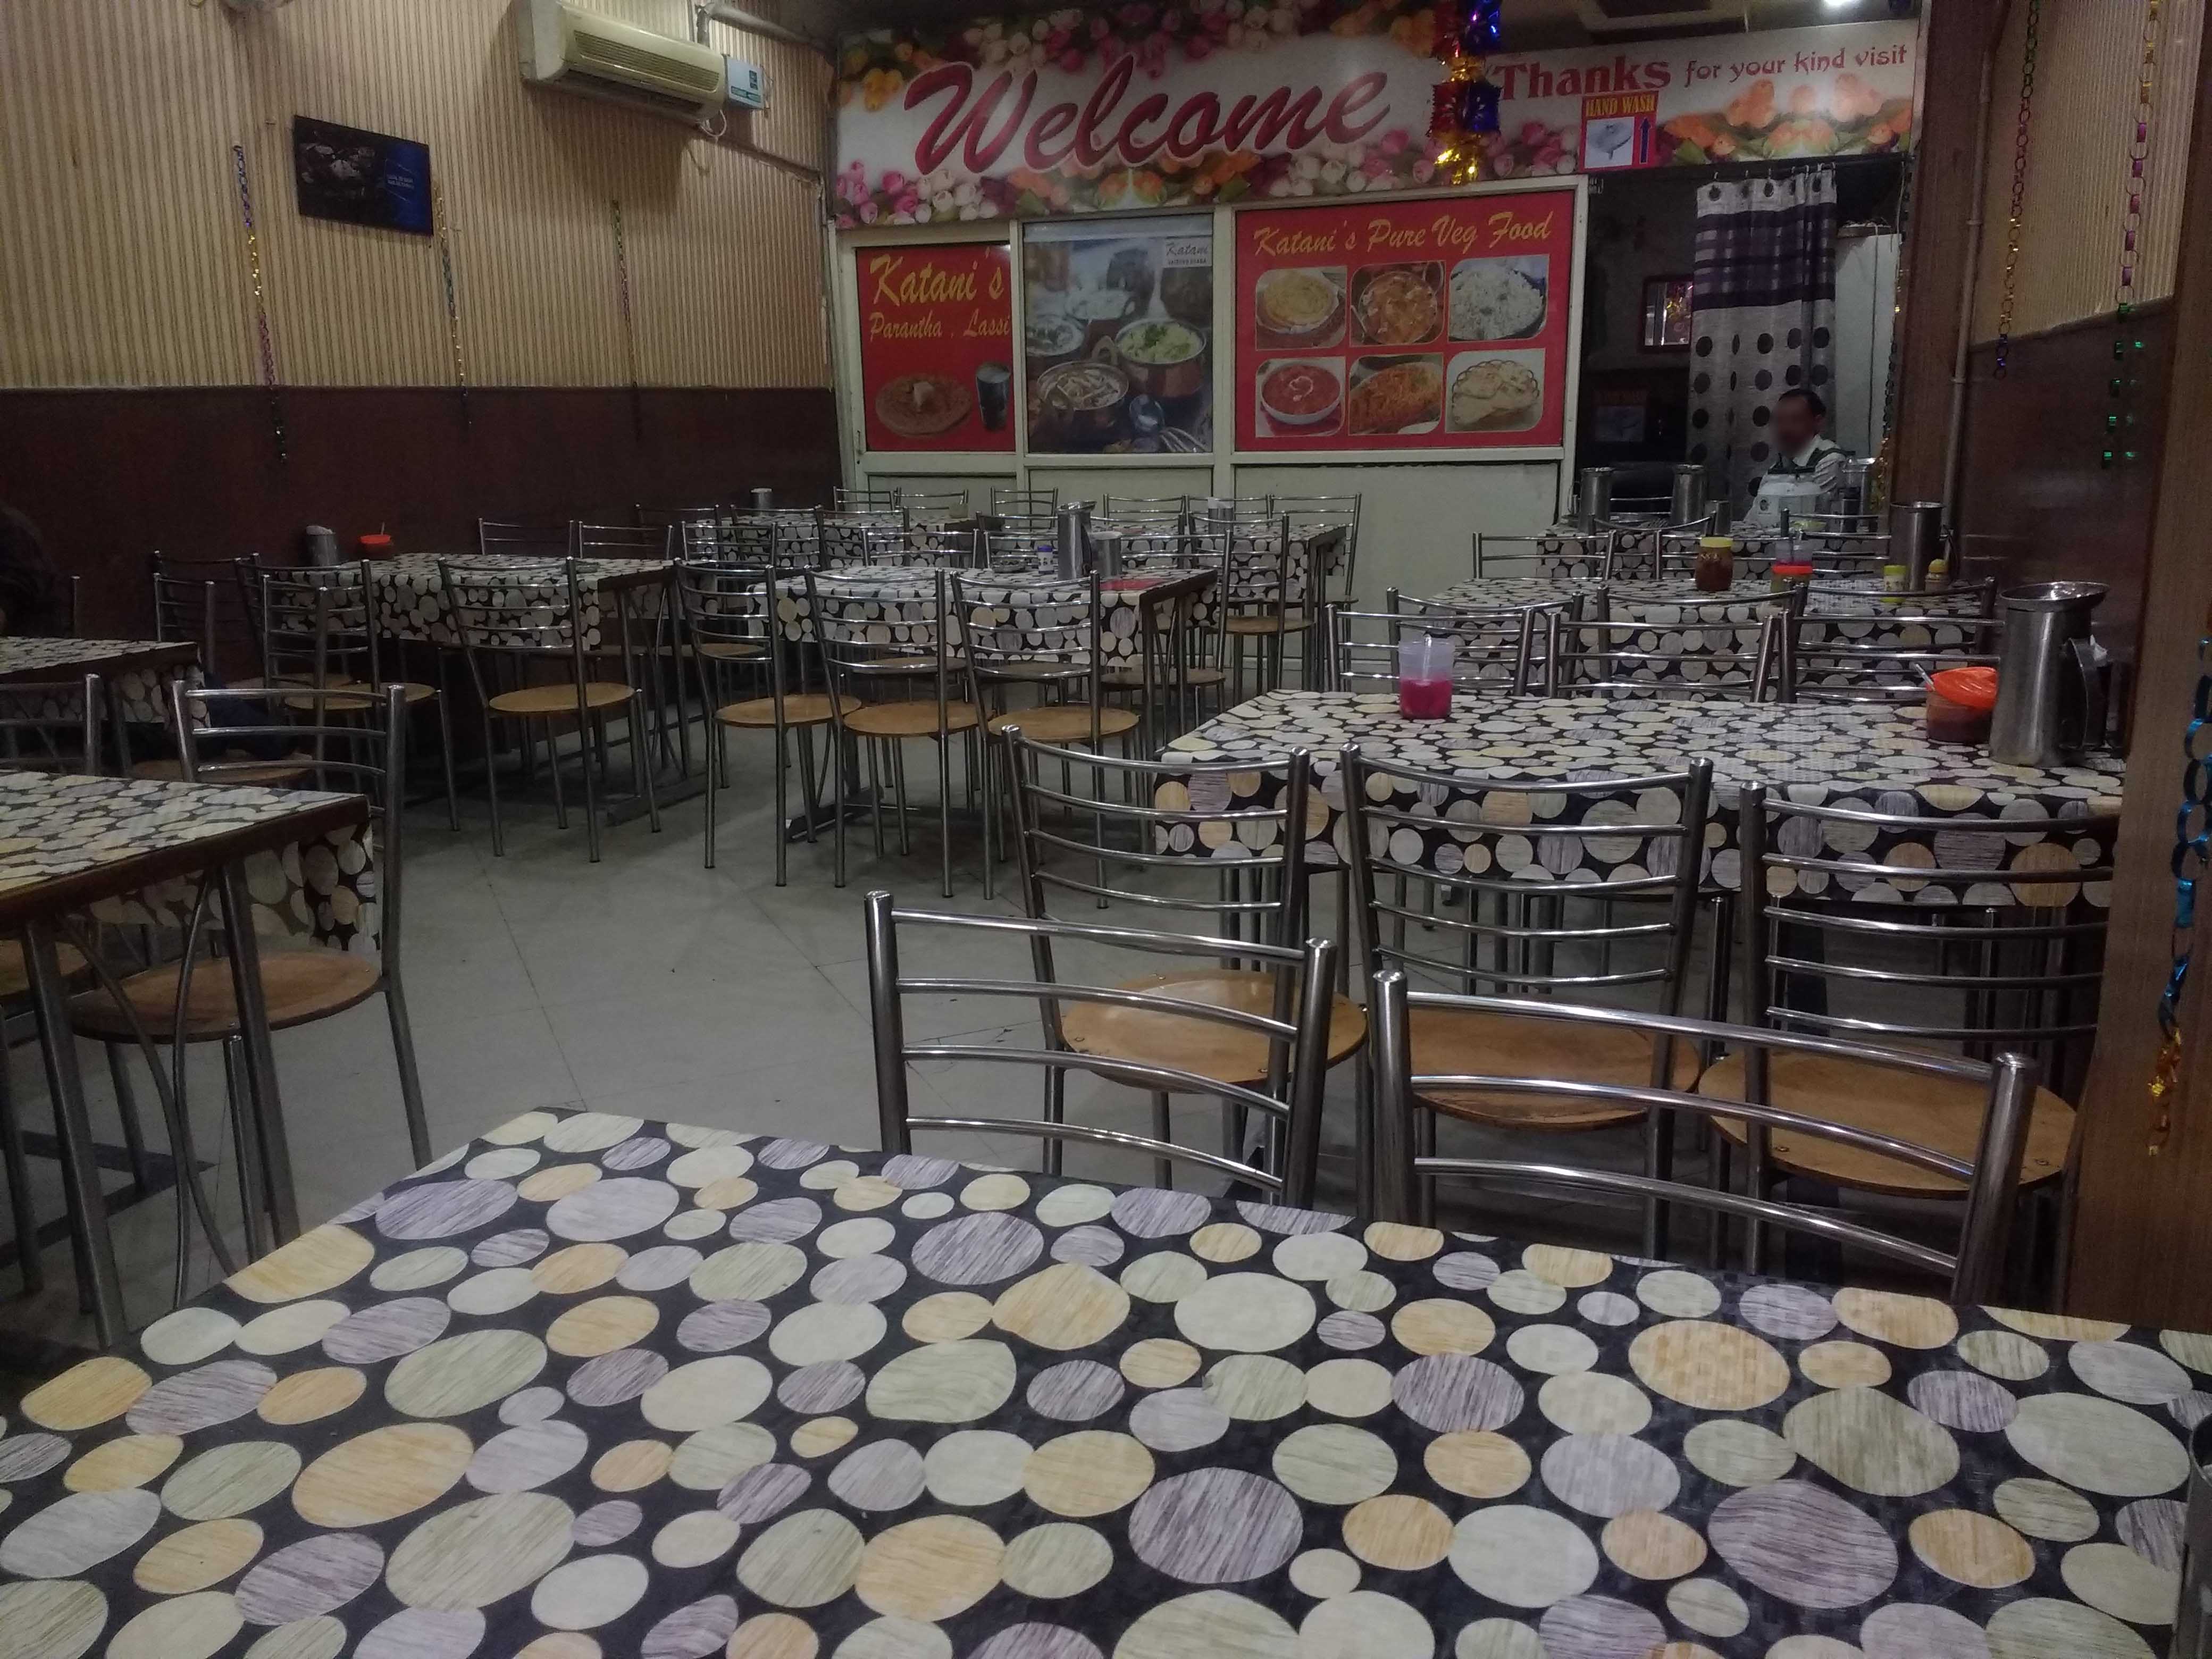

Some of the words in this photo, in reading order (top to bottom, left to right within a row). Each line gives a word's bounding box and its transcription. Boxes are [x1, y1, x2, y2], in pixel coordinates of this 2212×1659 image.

[1493, 55, 1671, 100] Thanks
[1685, 60, 1720, 88] for
[1730, 58, 1786, 83] your
[1794, 47, 1845, 74] kind
[1855, 44, 1907, 66] visit
[904, 54, 1390, 175] Welcome
[1586, 98, 1618, 116] HAND
[1622, 94, 1655, 113] WASH
[1254, 220, 1356, 256] Katani's
[1368, 219, 1426, 253] Pure
[1431, 214, 1478, 254] Veg
[1488, 210, 1554, 248] Food
[870, 246, 1004, 307] Katani's
[963, 308, 1010, 337] Lassi
